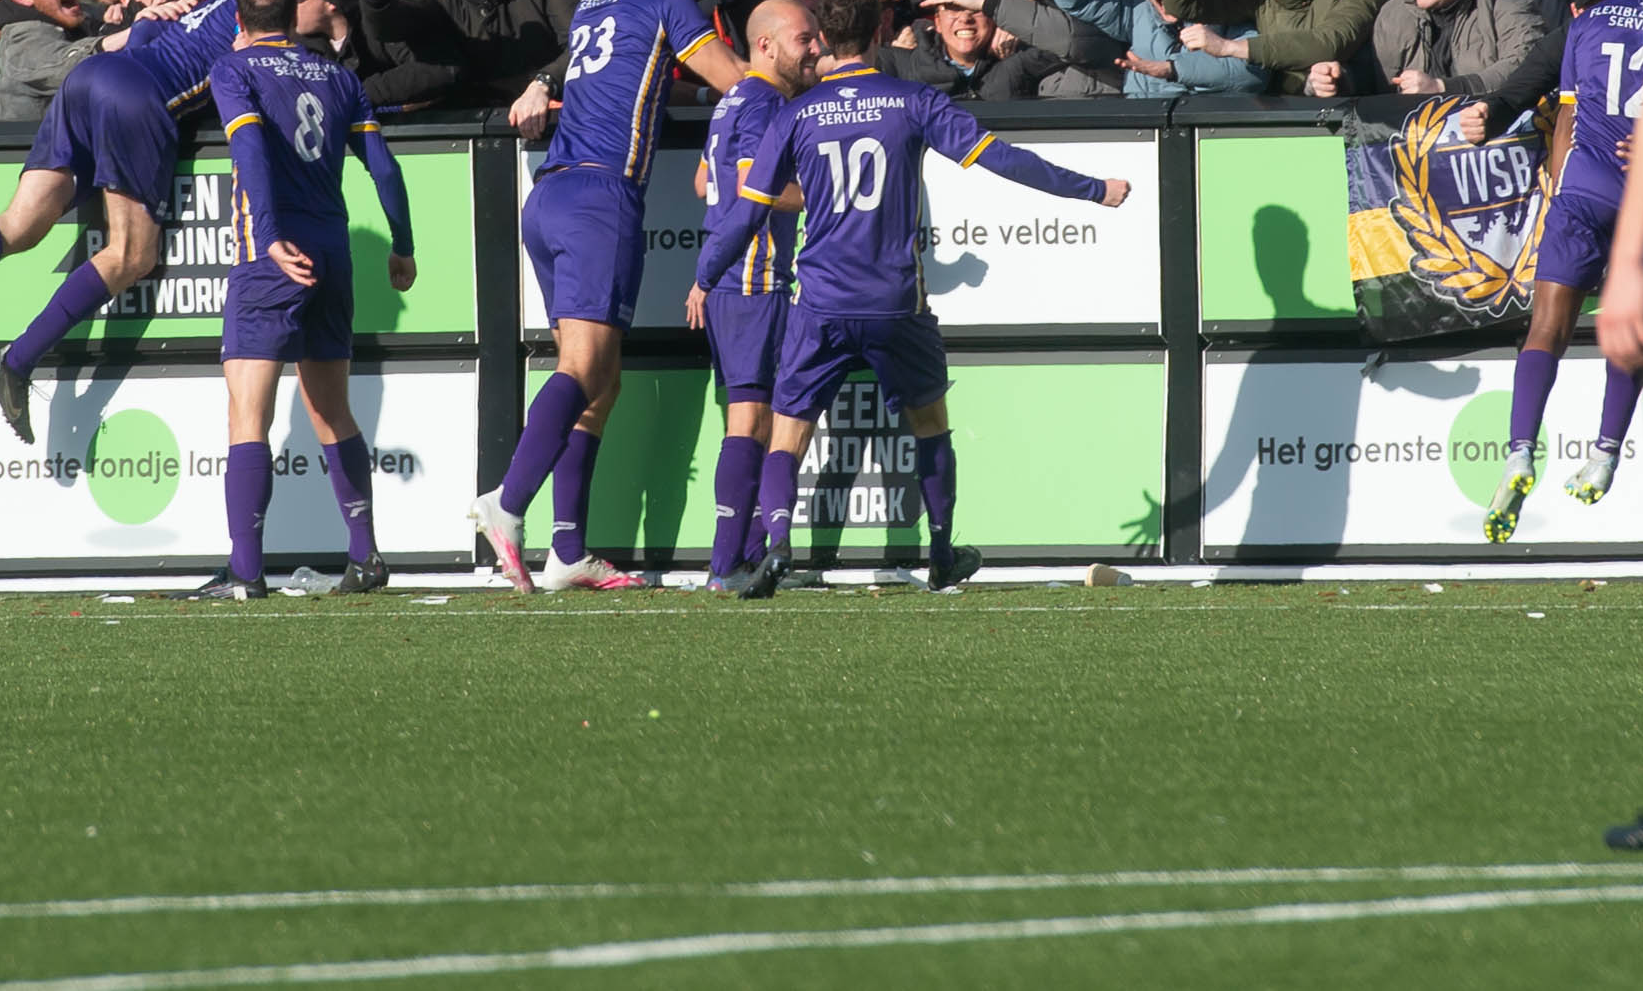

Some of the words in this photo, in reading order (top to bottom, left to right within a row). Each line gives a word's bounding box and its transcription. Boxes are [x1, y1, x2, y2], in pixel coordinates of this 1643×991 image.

[565, 16, 616, 83] 23
[817, 110, 883, 127] SERVICES
[856, 97, 905, 112] HUMAN
[294, 91, 324, 163] 8
[817, 137, 887, 214] 10
[1449, 145, 1533, 206] VVSB
[951, 220, 990, 248] de
[998, 218, 1098, 247] velden
[90, 447, 180, 485] rondje
[272, 448, 308, 476] de
[798, 435, 917, 475] ARDING
[1257, 435, 1306, 465] Het
[1314, 434, 1443, 472] groenste
[791, 485, 907, 524] ETWORK
